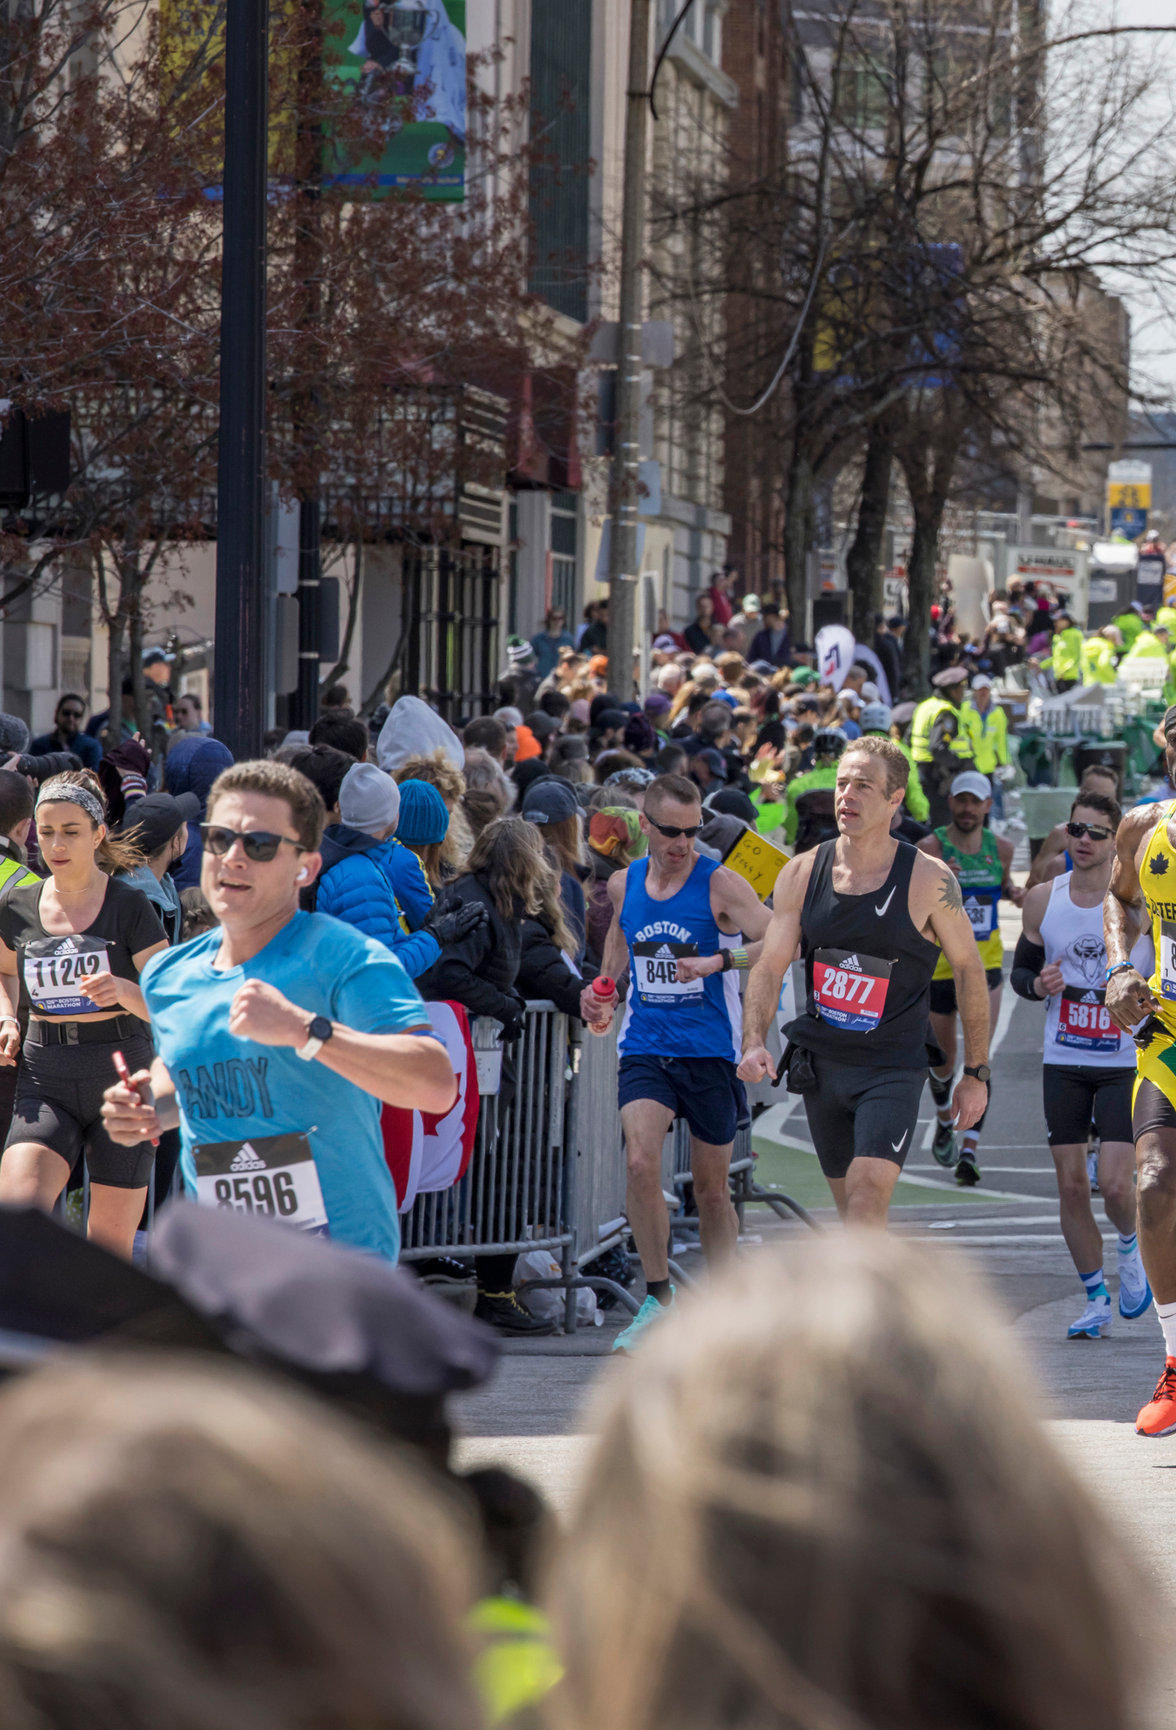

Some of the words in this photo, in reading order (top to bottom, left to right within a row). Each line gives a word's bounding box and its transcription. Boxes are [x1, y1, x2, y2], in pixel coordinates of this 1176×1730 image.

[742, 839, 761, 855] GO
[635, 920, 692, 943] BOSTON
[33, 954, 100, 988] 11242
[839, 963, 862, 973] adidas
[821, 967, 876, 1005] 2877
[1068, 1003, 1111, 1030] 5816
[230, 1160, 267, 1172] adidas
[215, 1172, 298, 1217] 8596
